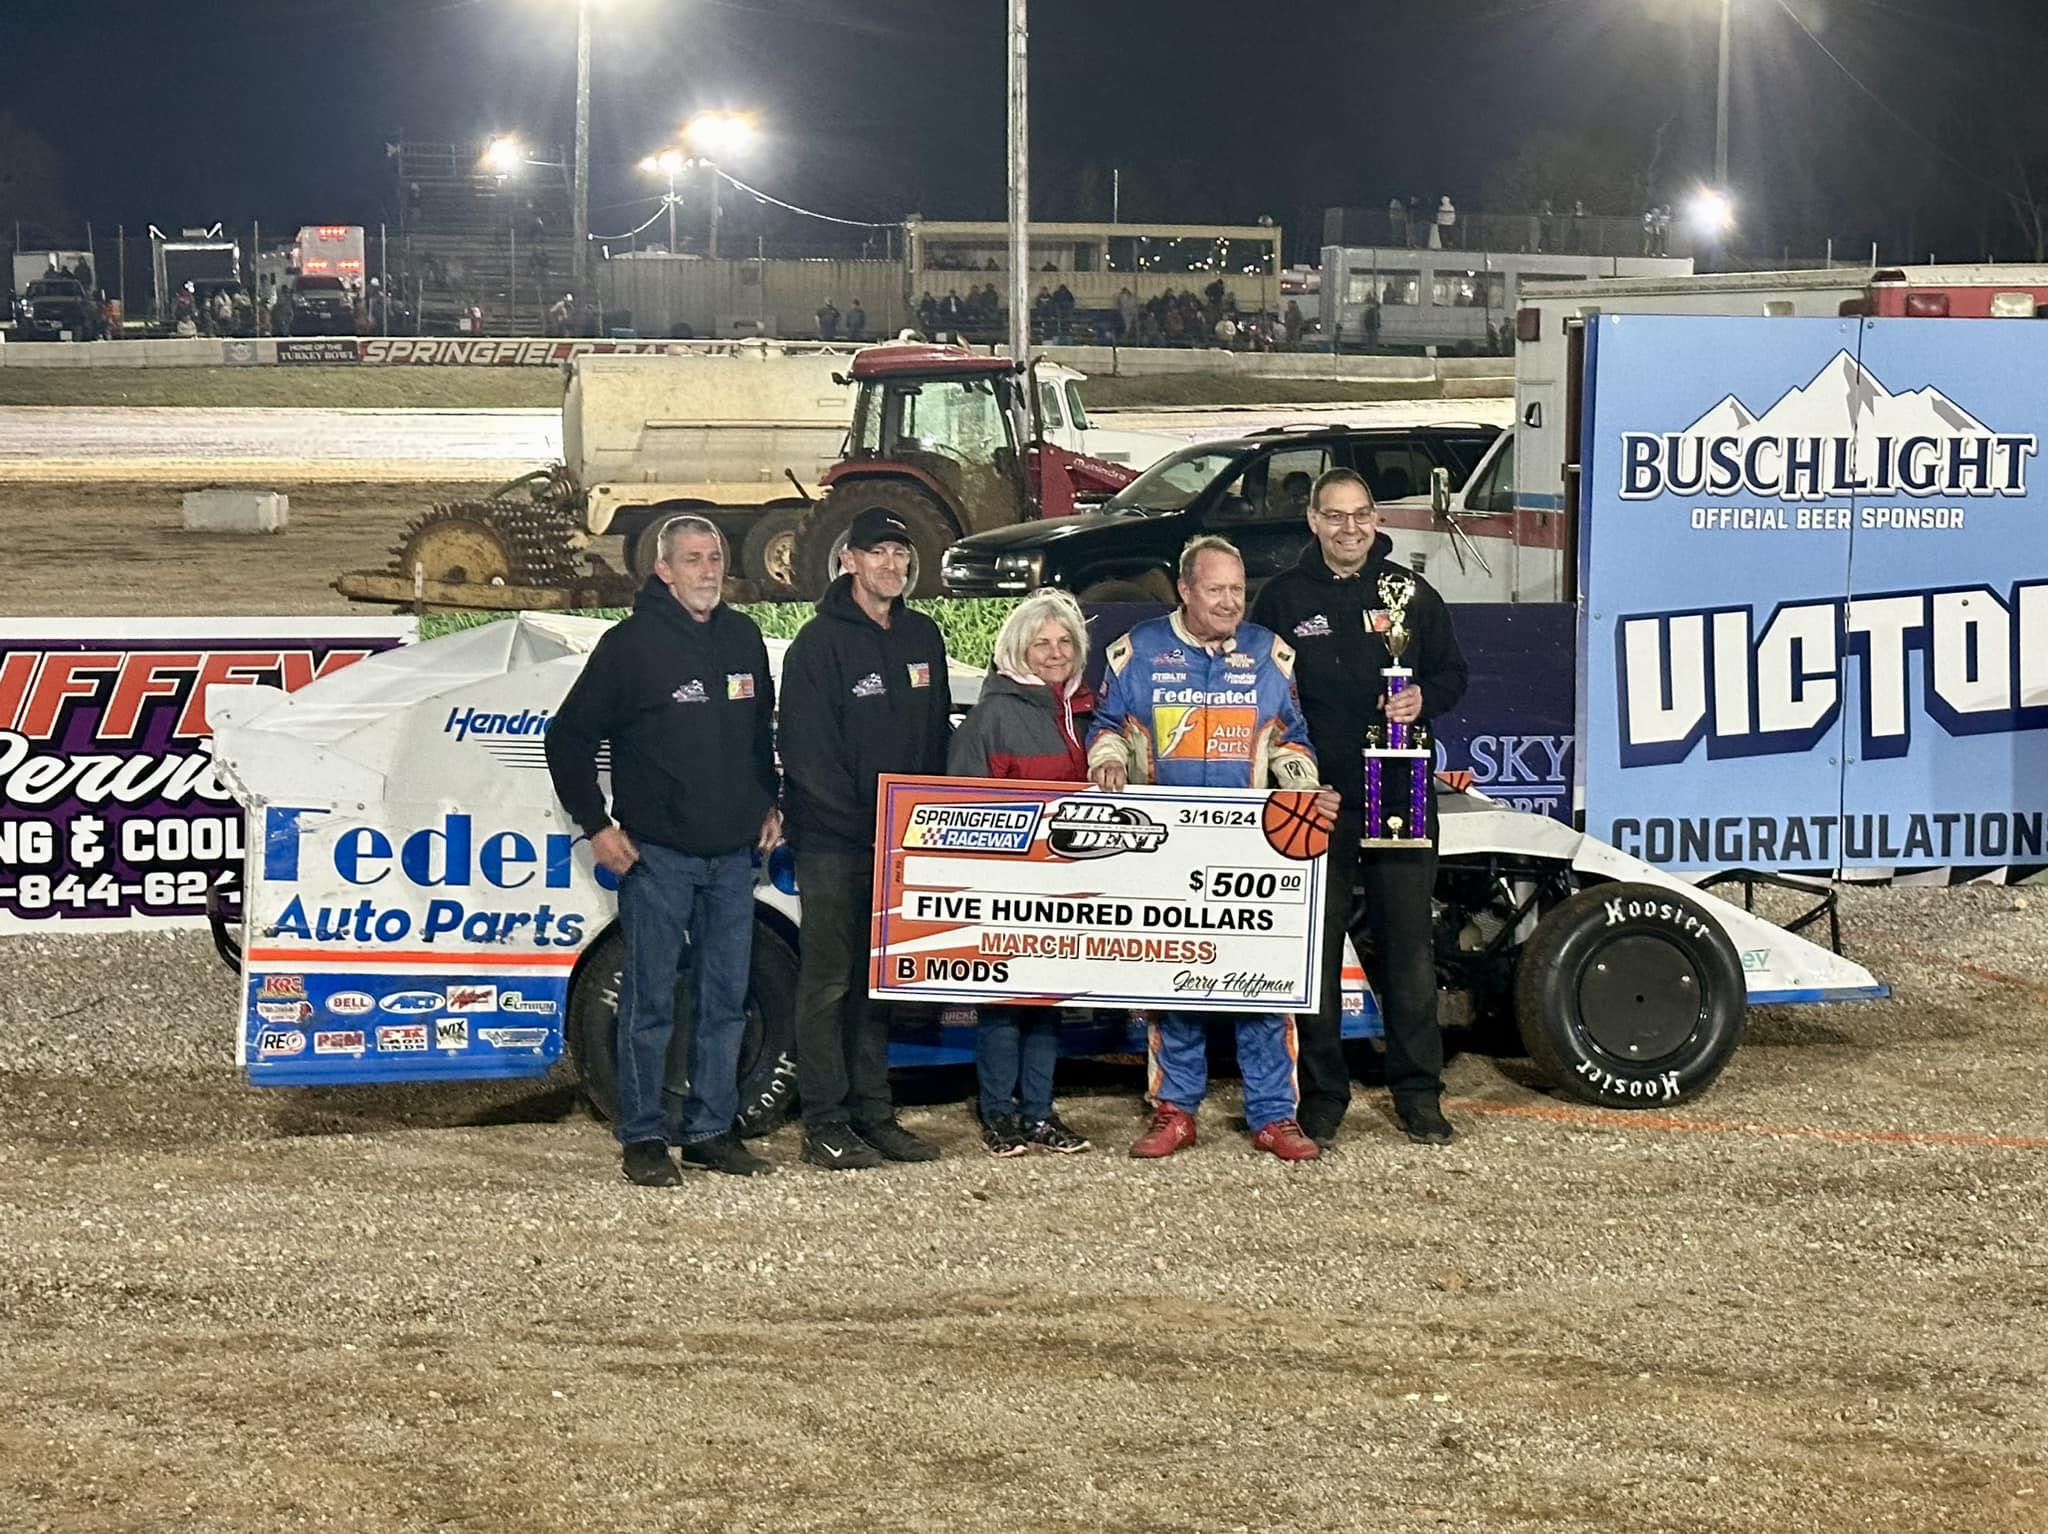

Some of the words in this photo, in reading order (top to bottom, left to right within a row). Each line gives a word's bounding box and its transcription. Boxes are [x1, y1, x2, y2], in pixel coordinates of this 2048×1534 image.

[280, 352, 322, 360] TURKEY
[324, 352, 356, 360] BOWL
[1691, 509, 1788, 529] OFFICIAL
[1796, 508, 1851, 529] BEER
[1861, 507, 1964, 529] SPONSOR
[1152, 688, 1257, 704] Federated
[1213, 724, 1250, 738] Auto
[1206, 739, 1250, 754] Parts
[1469, 735, 1575, 783] SKY
[914, 809, 1029, 830] SPRINGFIELD
[1179, 808, 1257, 825] 3/16/24
[71, 815, 105, 868] &
[122, 817, 245, 862] COOL
[945, 830, 1025, 848] RACEWAY
[1069, 830, 1167, 849] DENT
[1612, 811, 2048, 862] CONGRATULATION
[1188, 869, 1204, 893] $
[1211, 872, 1277, 898] 500
[270, 894, 411, 943] Auto
[423, 899, 585, 947] Parts
[917, 896, 982, 920] FIVE
[992, 899, 1133, 926] HUNDRED
[1143, 905, 1274, 931] DOLLARS
[1603, 896, 1709, 938] Hoosier
[979, 932, 1079, 958] MARCH
[1085, 936, 1217, 964] MADNESS
[898, 956, 917, 979] B
[926, 957, 1010, 984] MODS
[1173, 969, 1218, 997] Jerry
[1221, 971, 1295, 997] Hoffman
[333, 997, 369, 1008] BELL
[438, 1021, 465, 1037] WIX
[736, 1051, 797, 1127] Hoosi
[1576, 1059, 1682, 1100] Hoosier
